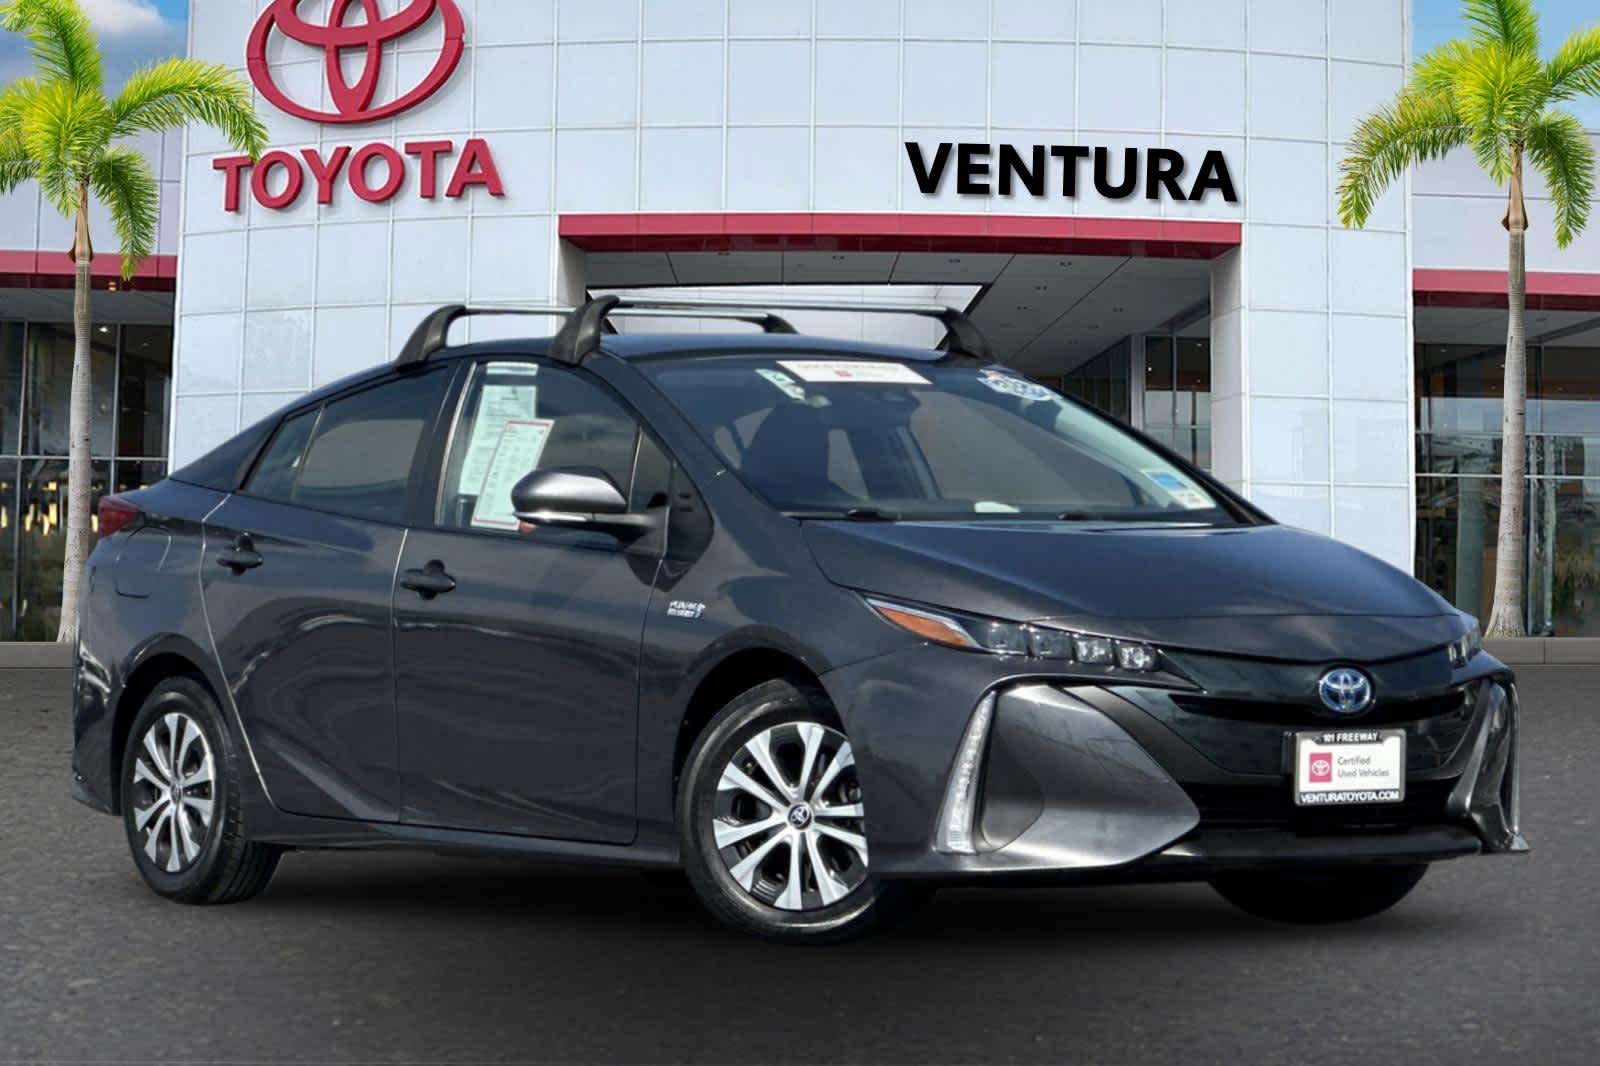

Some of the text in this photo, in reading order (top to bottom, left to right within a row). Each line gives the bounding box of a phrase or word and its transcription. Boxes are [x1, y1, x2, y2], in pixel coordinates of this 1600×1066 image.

[212, 138, 505, 213] TOYOTA
[904, 141, 1238, 203] VENTURA
[1336, 732, 1378, 742] FREEWAY
[1337, 755, 1371, 766] Certified
[1337, 768, 1358, 778] Used
[1301, 790, 1399, 803] VENTURATOYOTA.COM
